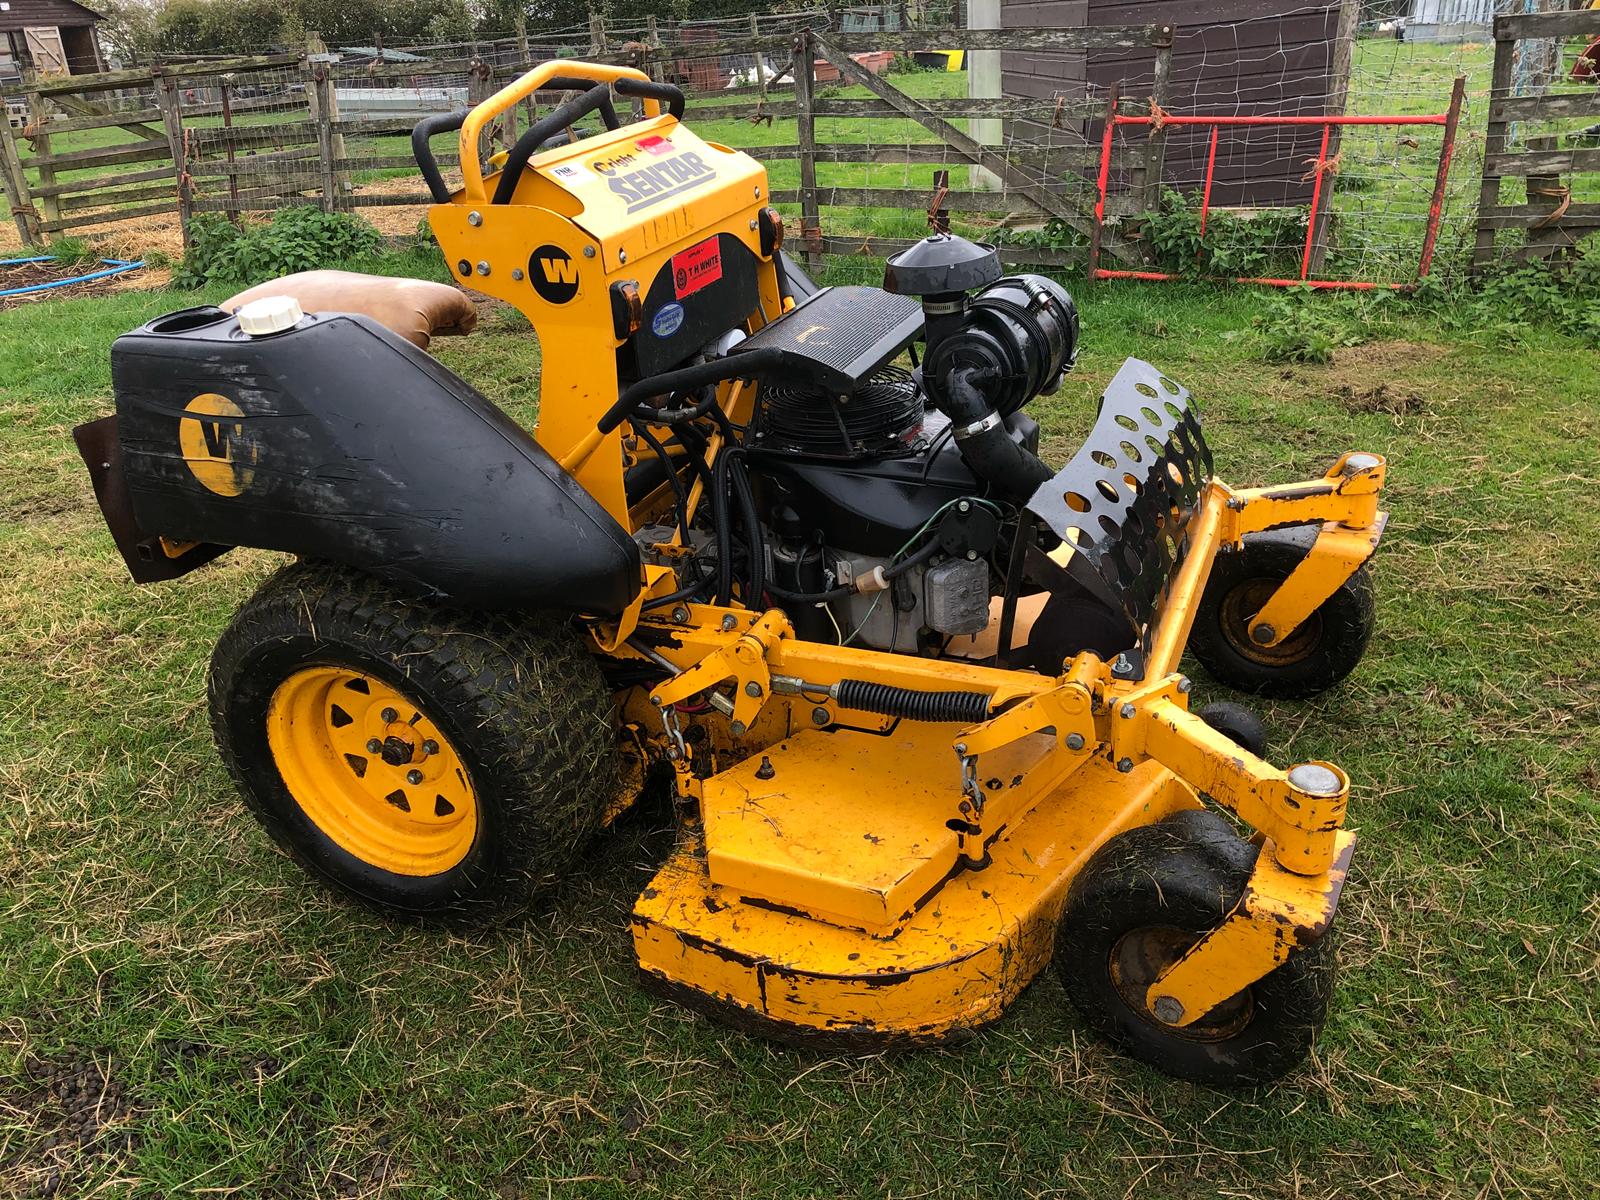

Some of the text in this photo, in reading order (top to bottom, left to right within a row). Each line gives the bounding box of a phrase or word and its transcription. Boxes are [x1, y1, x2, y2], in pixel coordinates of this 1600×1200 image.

[608, 151, 715, 205] SENTAR
[539, 257, 579, 284] W
[700, 254, 719, 271] WHITE
